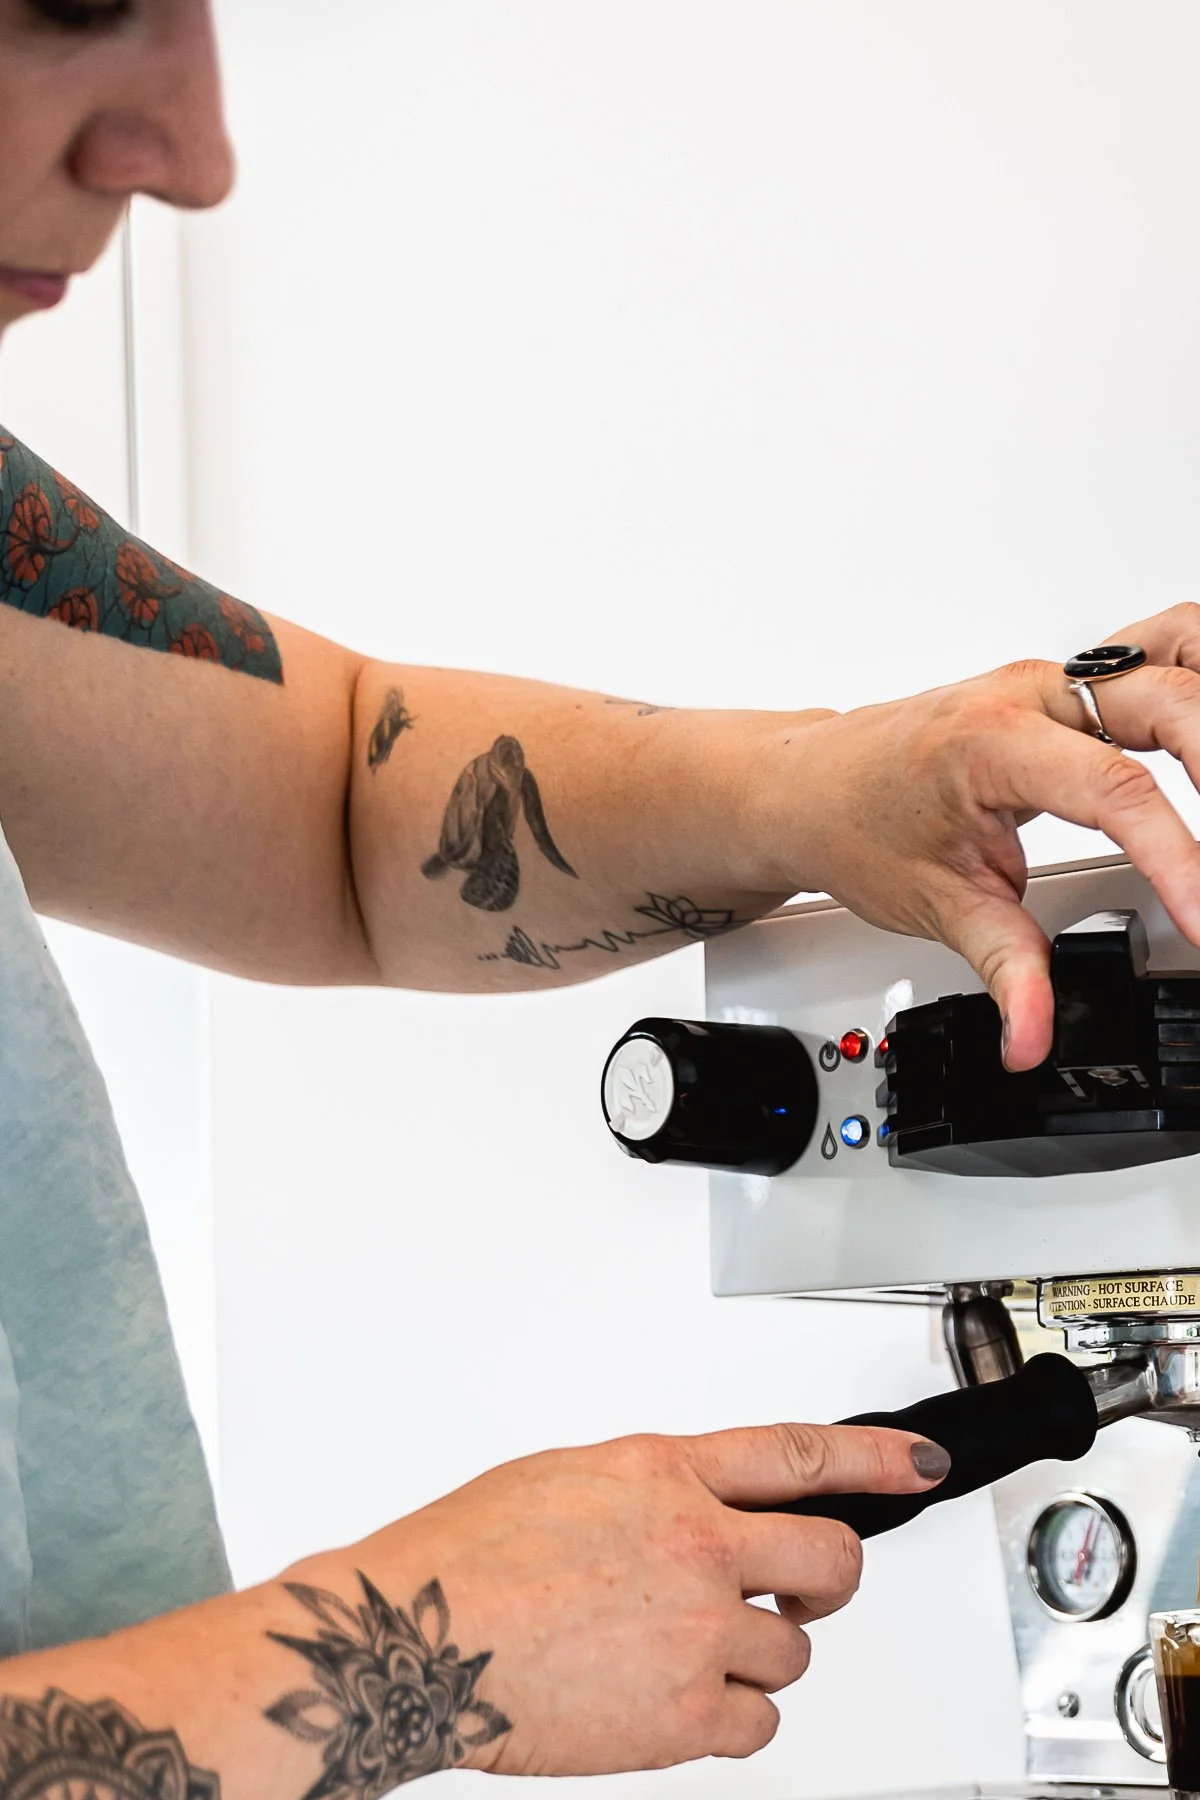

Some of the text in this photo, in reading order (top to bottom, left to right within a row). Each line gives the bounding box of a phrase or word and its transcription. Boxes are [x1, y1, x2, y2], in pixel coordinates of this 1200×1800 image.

[1052, 1285, 1090, 1298] WARNING
[1099, 1283, 1122, 1295] HOT
[1125, 1280, 1183, 1294] SURFACE
[1050, 1300, 1086, 1312] TTENTION
[1094, 1296, 1140, 1309] SURFACE
[1143, 1294, 1196, 1307] CHAUDE
